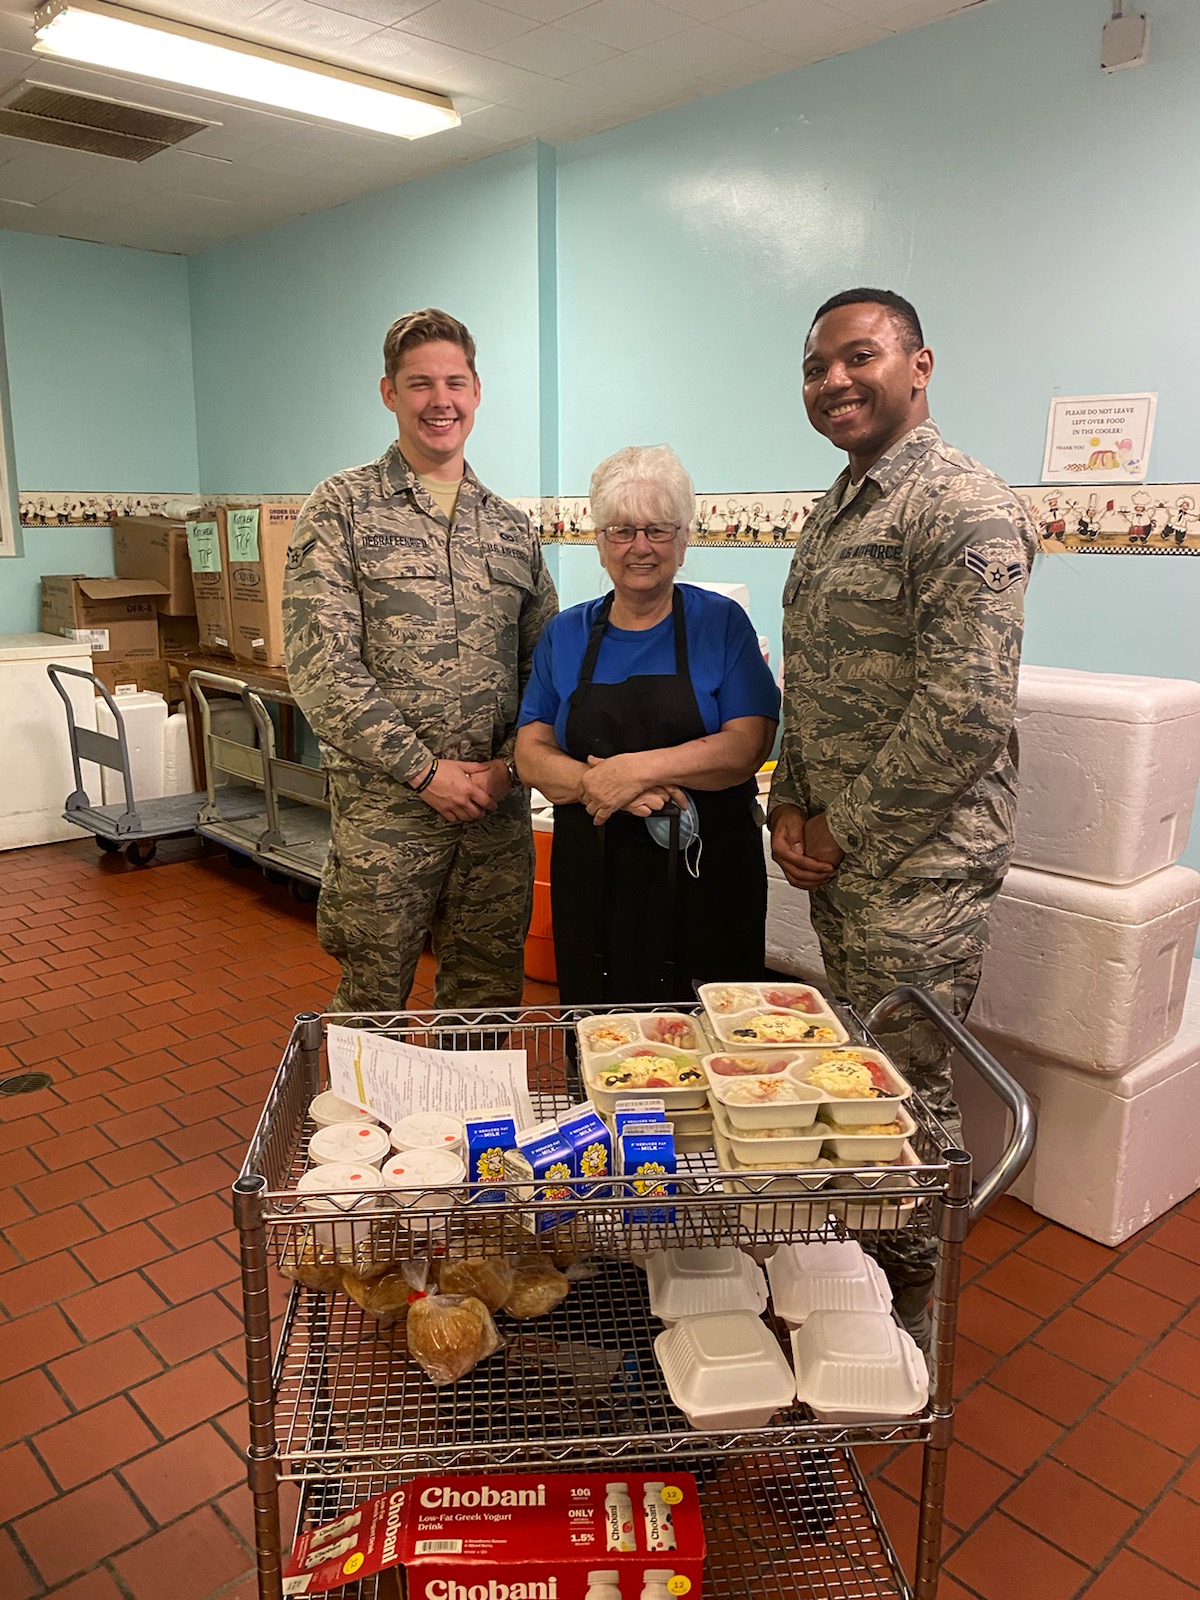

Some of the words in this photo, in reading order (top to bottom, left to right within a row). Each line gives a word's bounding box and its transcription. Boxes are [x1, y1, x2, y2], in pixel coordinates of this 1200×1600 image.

[1065, 408, 1086, 416] PLEASE
[579, 1127, 593, 1136] MILK
[541, 1147, 556, 1155] MILK
[420, 1483, 546, 1509] Chobani
[570, 1488, 591, 1497] 10G
[418, 1513, 454, 1523] Low-Fat
[455, 1512, 482, 1521] Greek
[483, 1512, 512, 1522] Yogurt
[568, 1509, 595, 1518] ONLY
[417, 1522, 444, 1531] Drink
[609, 1504, 620, 1541] Chobani
[648, 1504, 660, 1540] Chobani
[381, 1491, 405, 1564] Chobani
[570, 1533, 595, 1542] 1.5%
[425, 1576, 557, 1600] Chobani
[674, 1581, 685, 1589] 12
